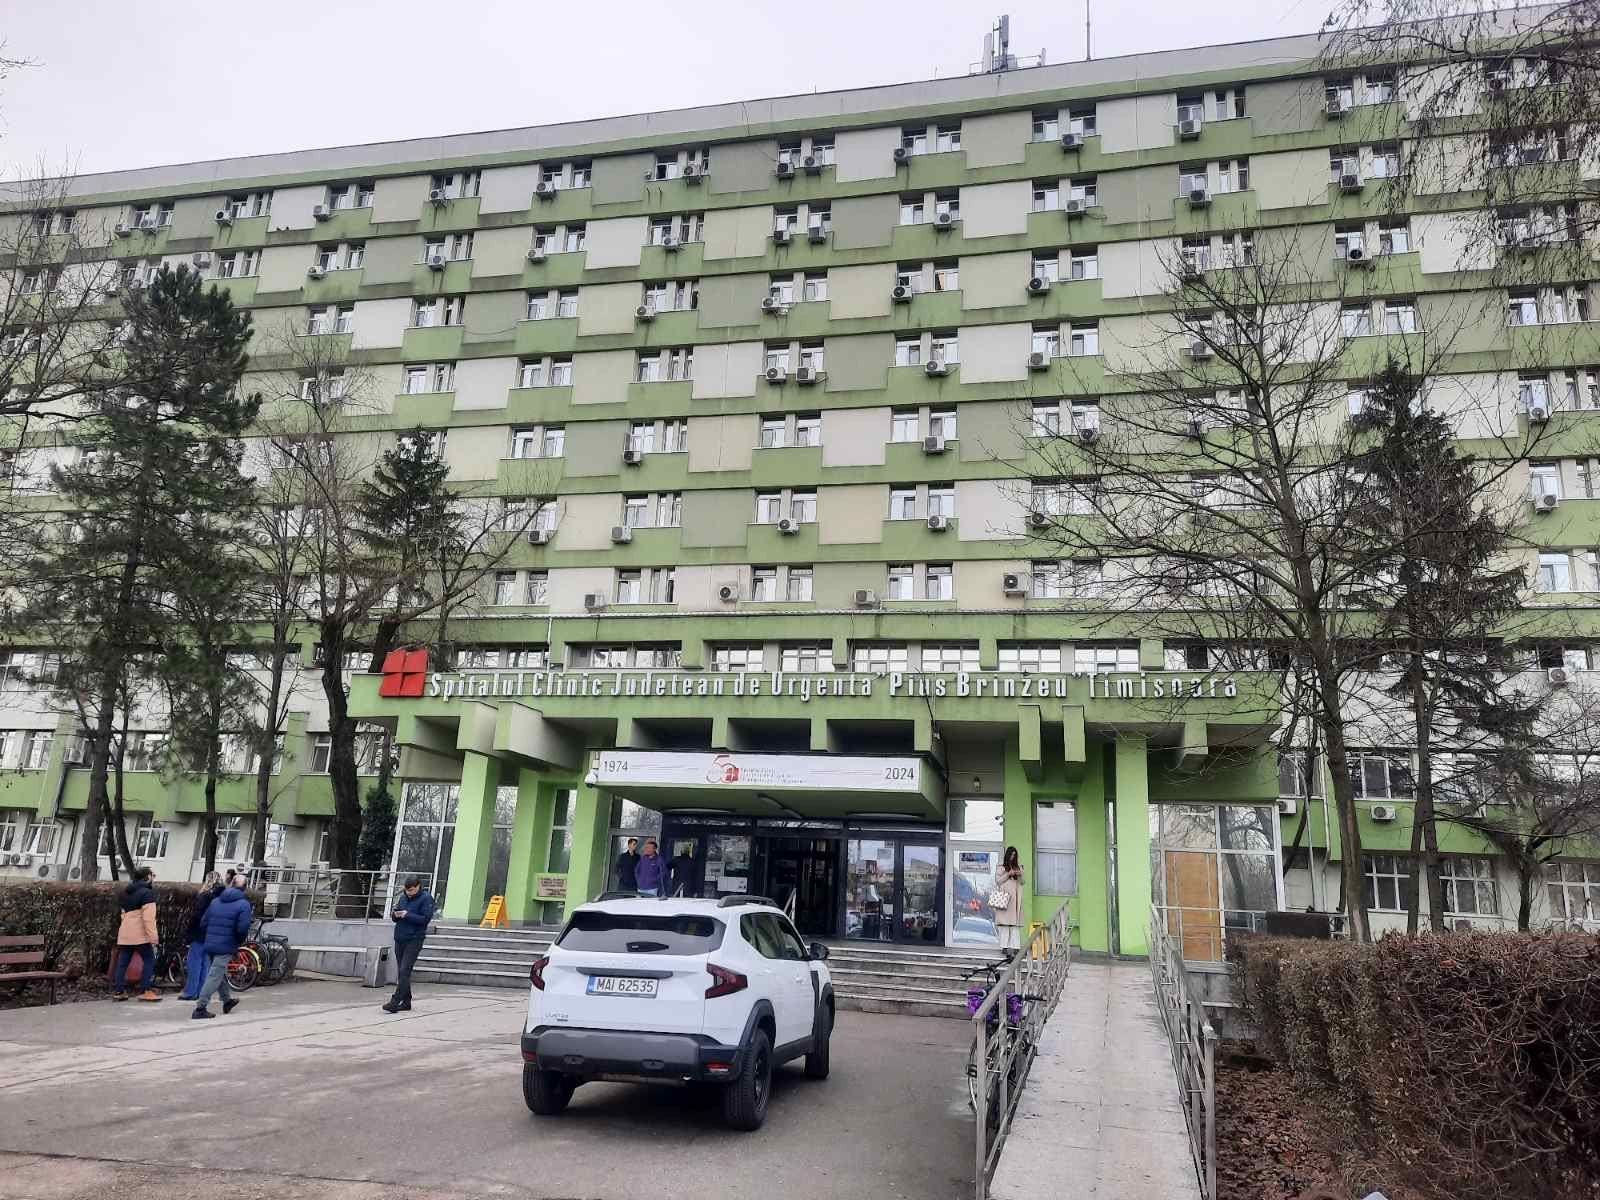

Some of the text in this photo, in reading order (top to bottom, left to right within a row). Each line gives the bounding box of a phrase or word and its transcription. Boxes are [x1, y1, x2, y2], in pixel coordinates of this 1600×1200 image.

[430, 672, 524, 702] Spitalul
[532, 672, 602, 696] Clinic
[610, 672, 724, 696] Judetean
[734, 672, 761, 696] de
[771, 672, 872, 702] Urgenta
[1087, 671, 1237, 698] Timisoara
[604, 760, 629, 773] 1974
[885, 767, 914, 780] 2024
[596, 978, 654, 993] MAI 62535
